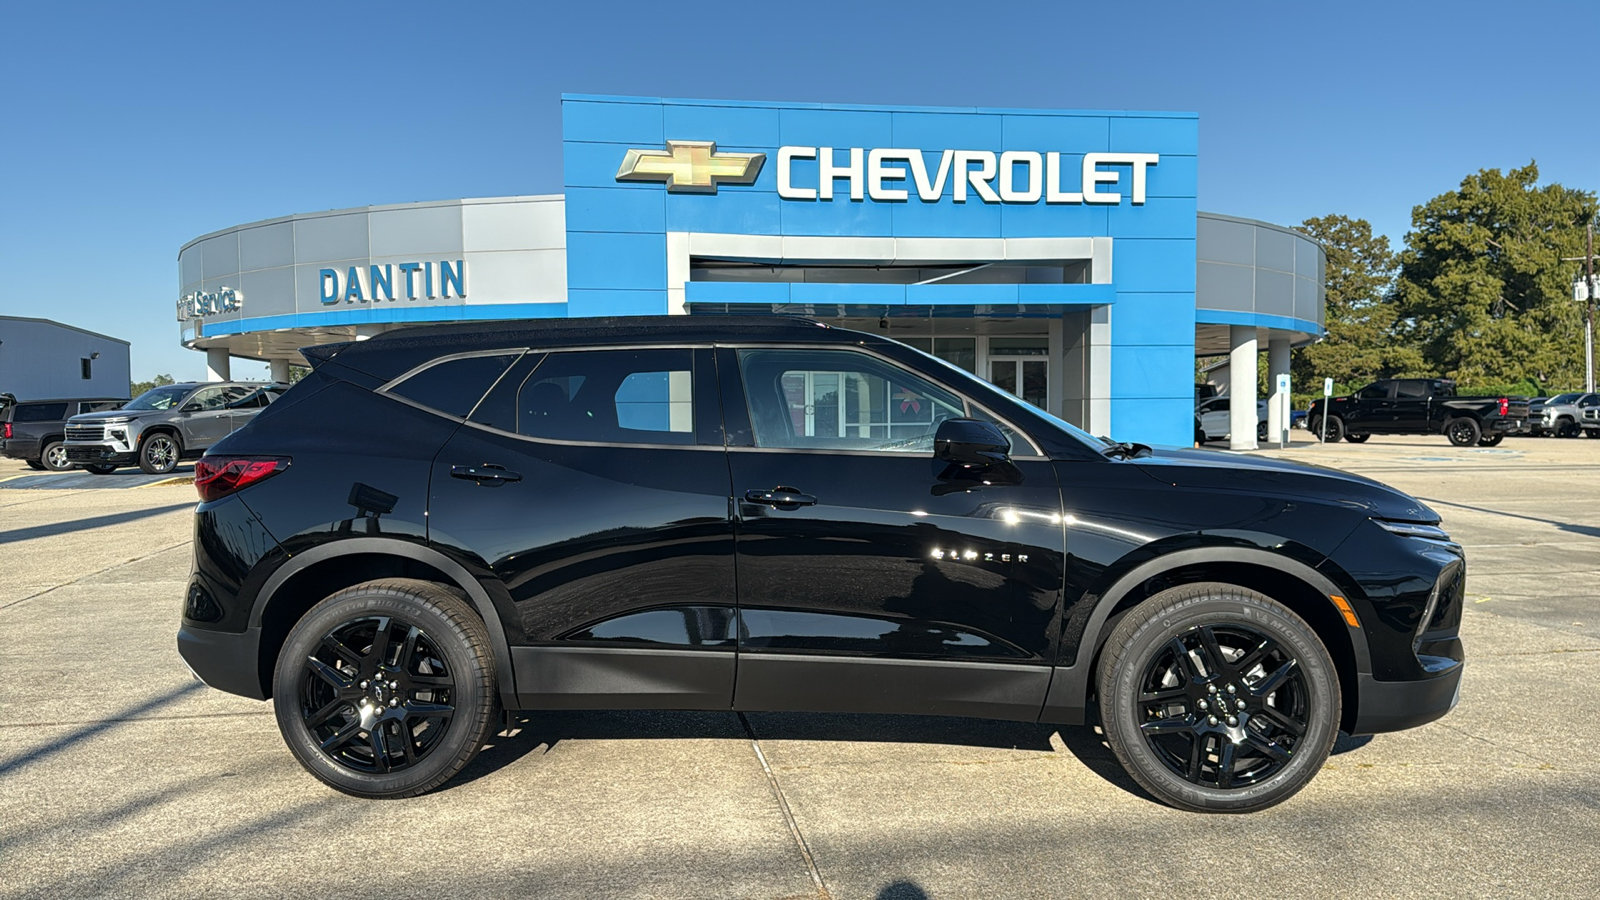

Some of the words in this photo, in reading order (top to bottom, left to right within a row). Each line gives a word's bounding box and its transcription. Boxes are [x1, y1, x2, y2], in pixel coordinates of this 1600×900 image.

[777, 146, 1160, 204] CHEVROLET
[196, 286, 241, 315] Service
[319, 260, 466, 305] DANTIN
[1269, 620, 1319, 667] MICHELIN
